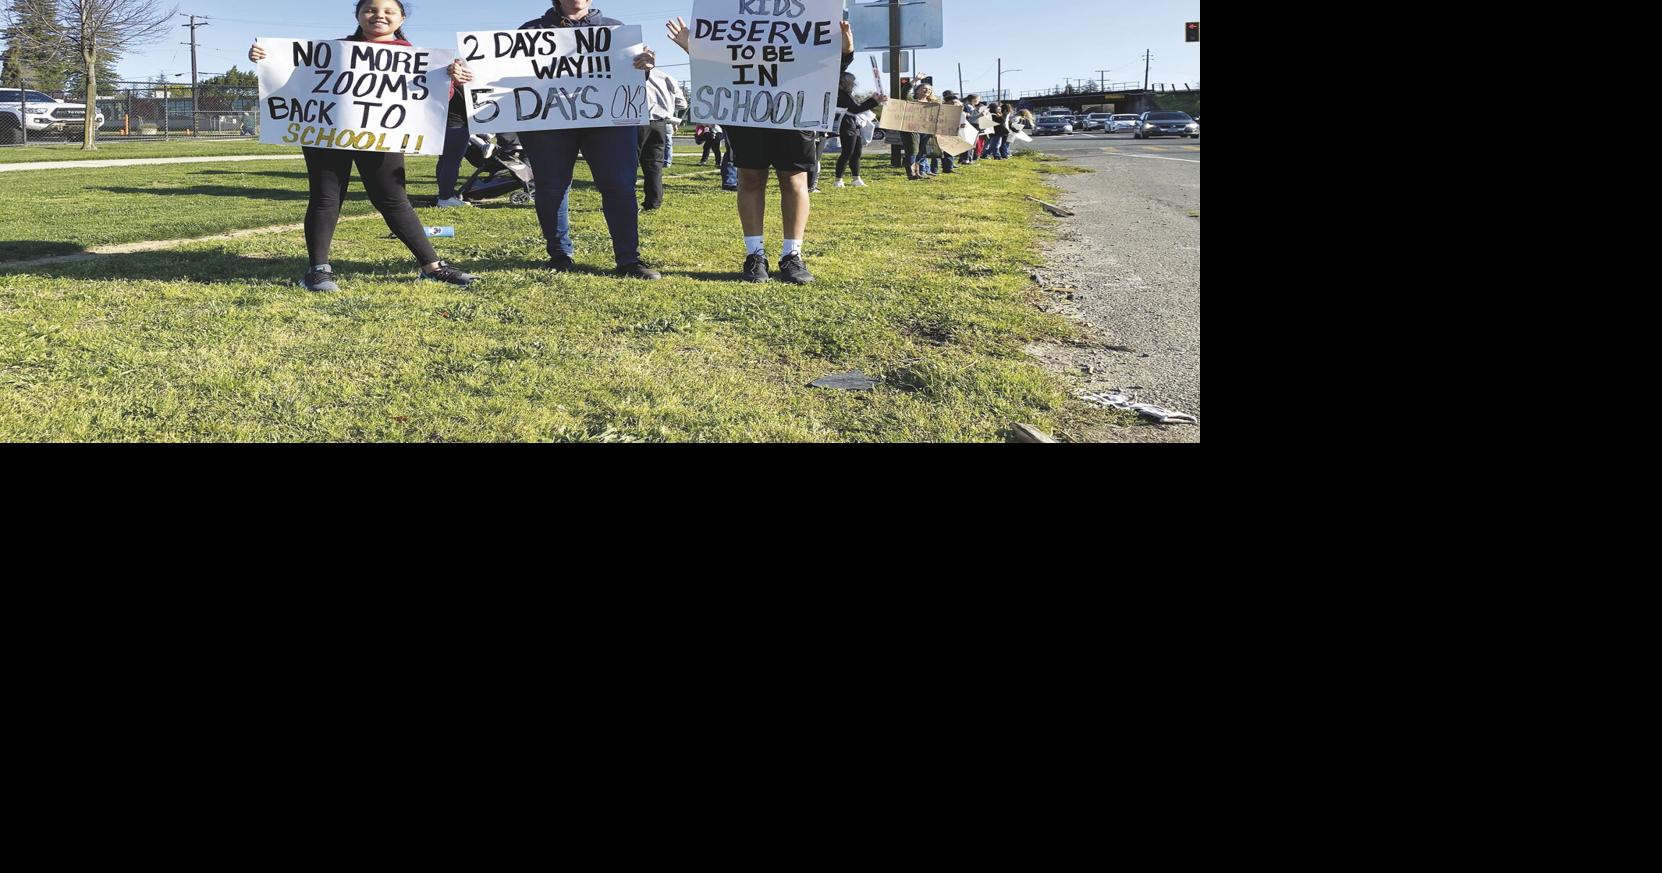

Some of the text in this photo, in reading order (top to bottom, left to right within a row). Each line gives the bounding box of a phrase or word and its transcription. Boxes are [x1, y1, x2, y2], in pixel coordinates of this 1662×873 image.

[463, 27, 611, 61] 2 DAYS NO
[694, 18, 832, 46] DESERVE
[292, 41, 429, 75] NO MORE
[531, 56, 612, 79] WAY!!!
[726, 44, 795, 62] TO BE
[311, 70, 429, 101] ZOOMS
[731, 63, 778, 87] IN
[267, 96, 406, 129] BACK TO
[470, 84, 647, 124] 5 DAYS OK?
[693, 85, 832, 130] SCHOOL!
